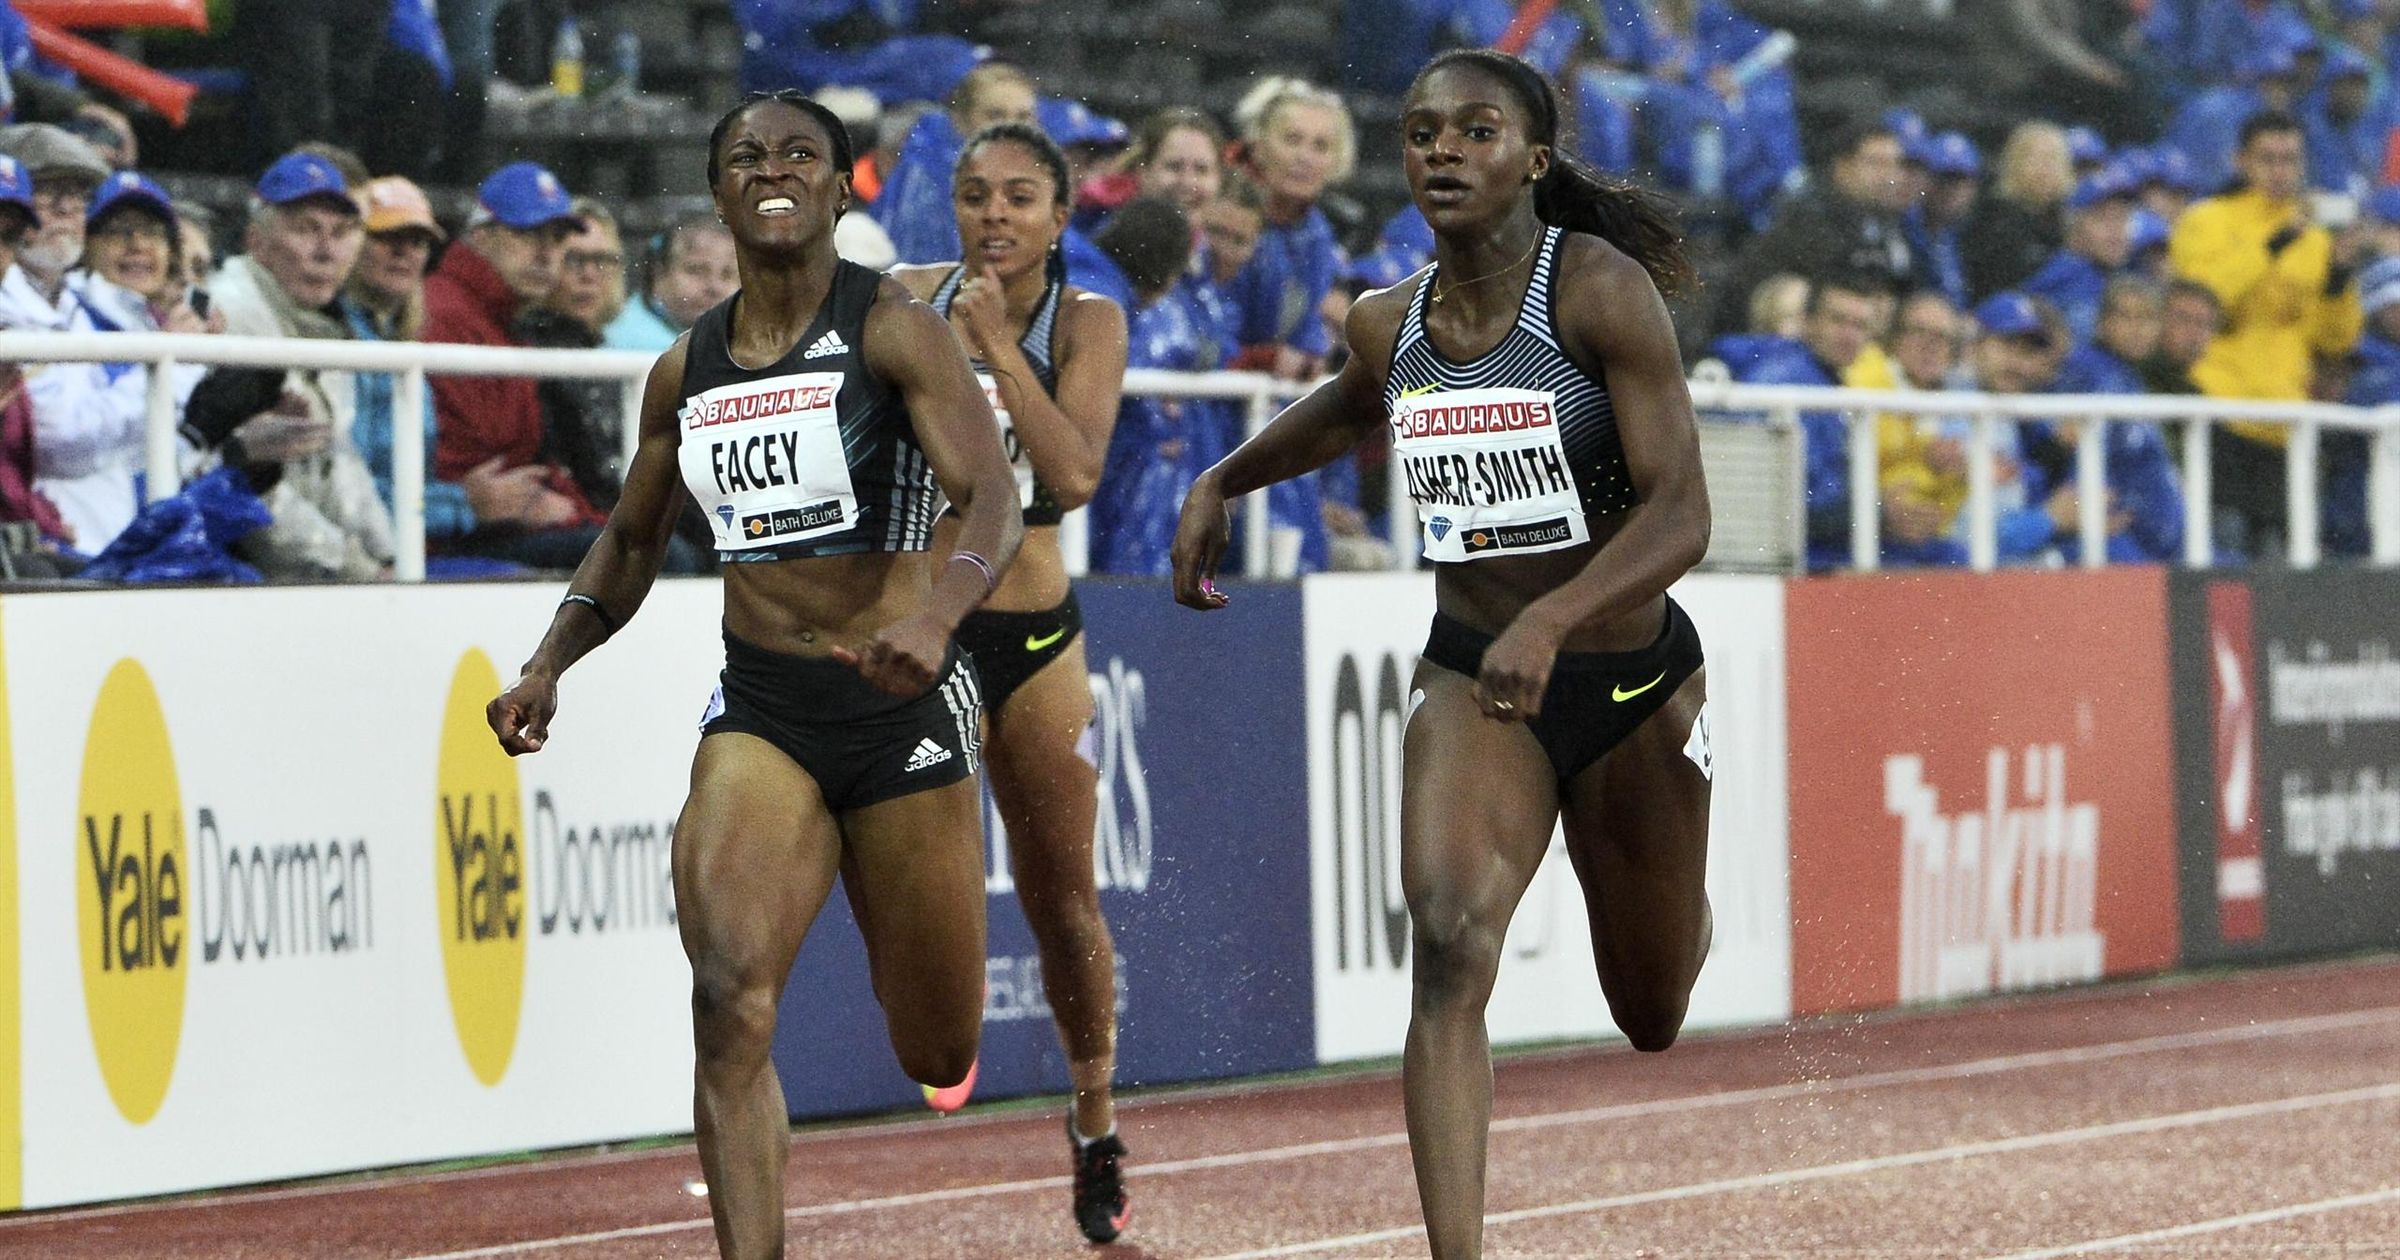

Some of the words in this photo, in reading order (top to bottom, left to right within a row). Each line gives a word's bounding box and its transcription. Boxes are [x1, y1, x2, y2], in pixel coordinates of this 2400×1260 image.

[804, 345, 849, 360] adidas
[705, 387, 835, 425] BAUHAUS
[1414, 402, 1552, 437] BAUHAUS
[711, 430, 799, 495] FACEY
[1403, 444, 1569, 507] ASHER-SMITH
[774, 517, 800, 532] BATH
[802, 507, 841, 527] DELUXE
[1500, 531, 1528, 546] BATH
[1529, 524, 1568, 542] DELUXE
[904, 749, 952, 772] adidas
[443, 793, 520, 942] Yale
[536, 789, 677, 935] Doorma
[85, 810, 182, 972] Yale
[197, 806, 374, 963] Doorman
